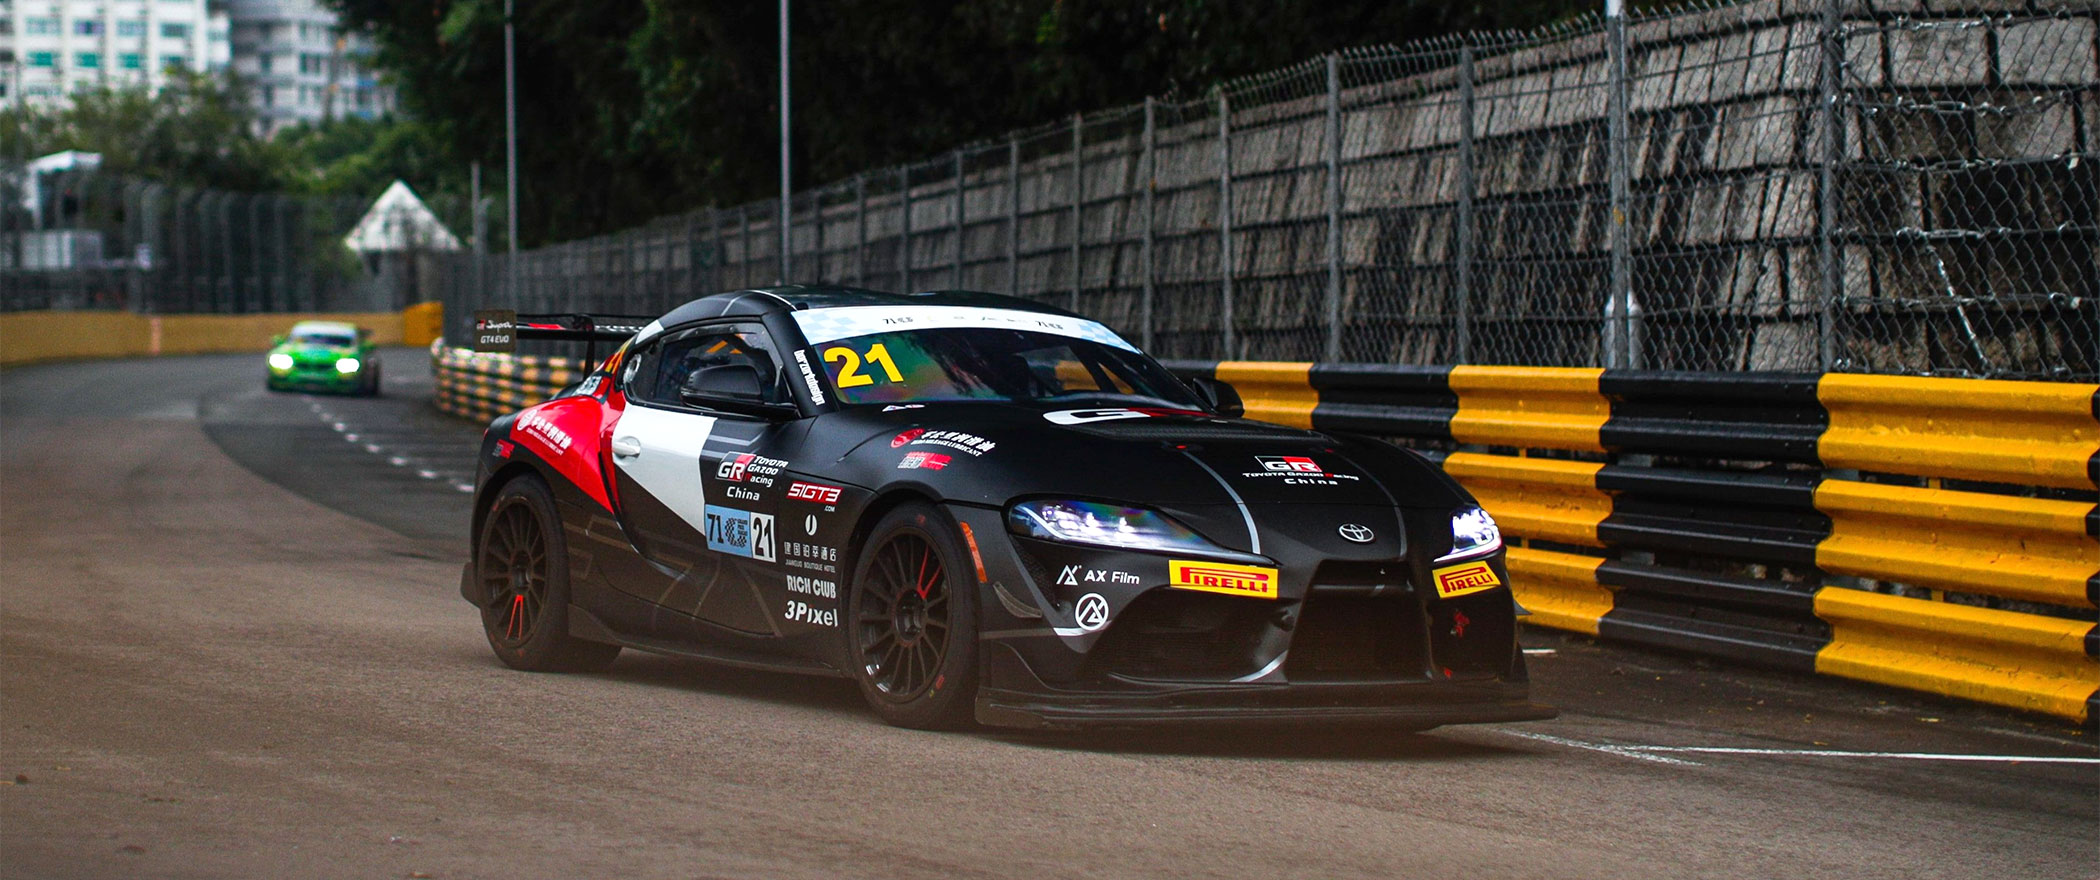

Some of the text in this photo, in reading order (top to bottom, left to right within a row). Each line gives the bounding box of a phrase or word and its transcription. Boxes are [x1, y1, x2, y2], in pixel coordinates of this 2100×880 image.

[486, 320, 514, 333] Supra
[480, 335, 510, 344] GT4 EVO
[823, 343, 904, 389] 21
[747, 463, 779, 475] GAZOO
[754, 455, 789, 468] TOYOTA
[1264, 461, 1319, 472] GR
[718, 461, 746, 480] GR
[1284, 478, 1339, 486] China
[727, 486, 760, 501] China
[707, 513, 774, 559] 71 21
[1084, 569, 1140, 585] AX Film
[1180, 567, 1269, 593] PIRELLI
[1439, 566, 1494, 594] PIRELLI
[786, 574, 837, 599] RICH CLUB
[784, 600, 839, 627] 3Pixel
